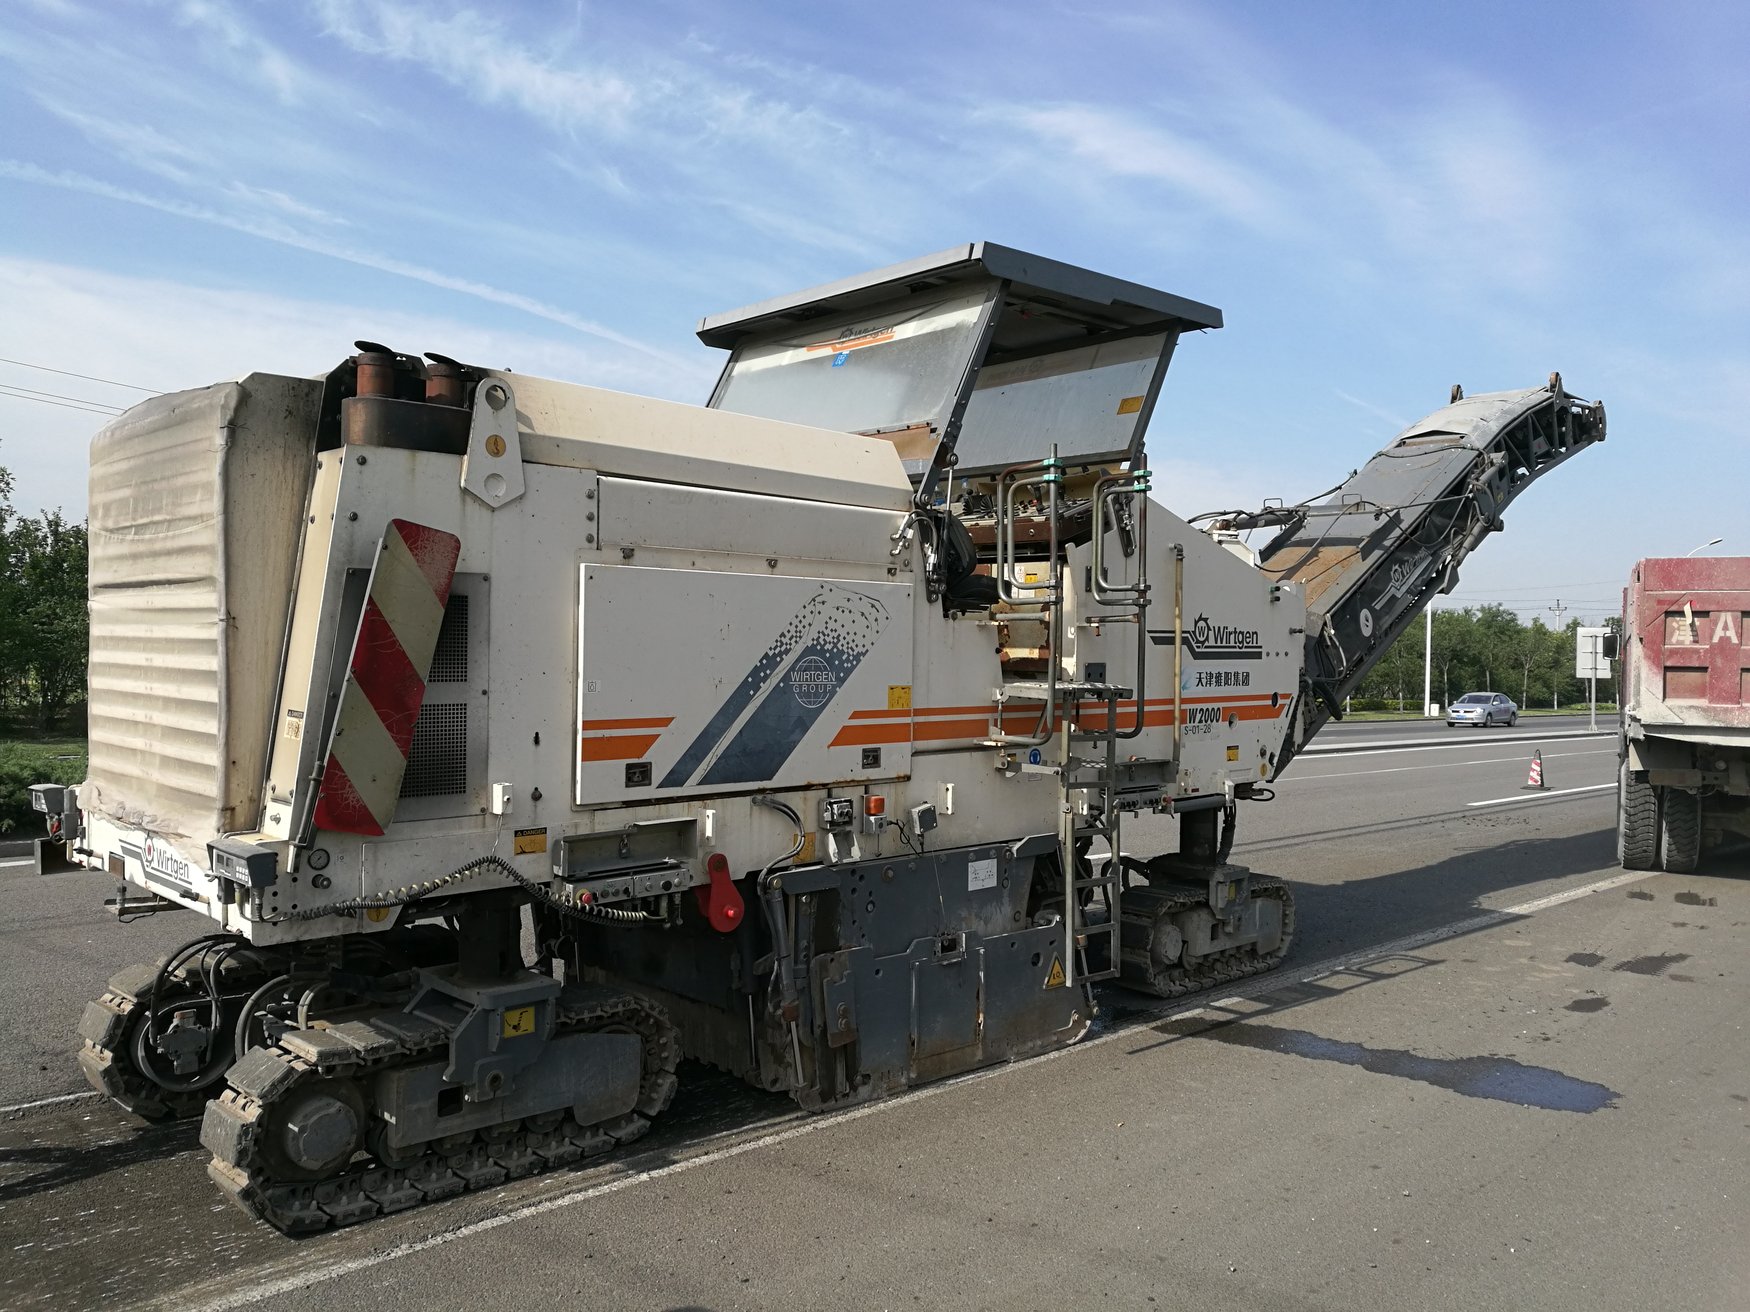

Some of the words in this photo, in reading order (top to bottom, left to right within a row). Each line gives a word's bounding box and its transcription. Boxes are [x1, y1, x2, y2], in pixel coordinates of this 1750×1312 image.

[1213, 626, 1259, 650] Wirtgen
[791, 671, 836, 682] WIRTGEN
[1195, 671, 1250, 687] 天津雍阳集团
[1188, 707, 1221, 724] W2000
[1184, 723, 1212, 735] S-01-28
[156, 847, 189, 880] Wirtgen
